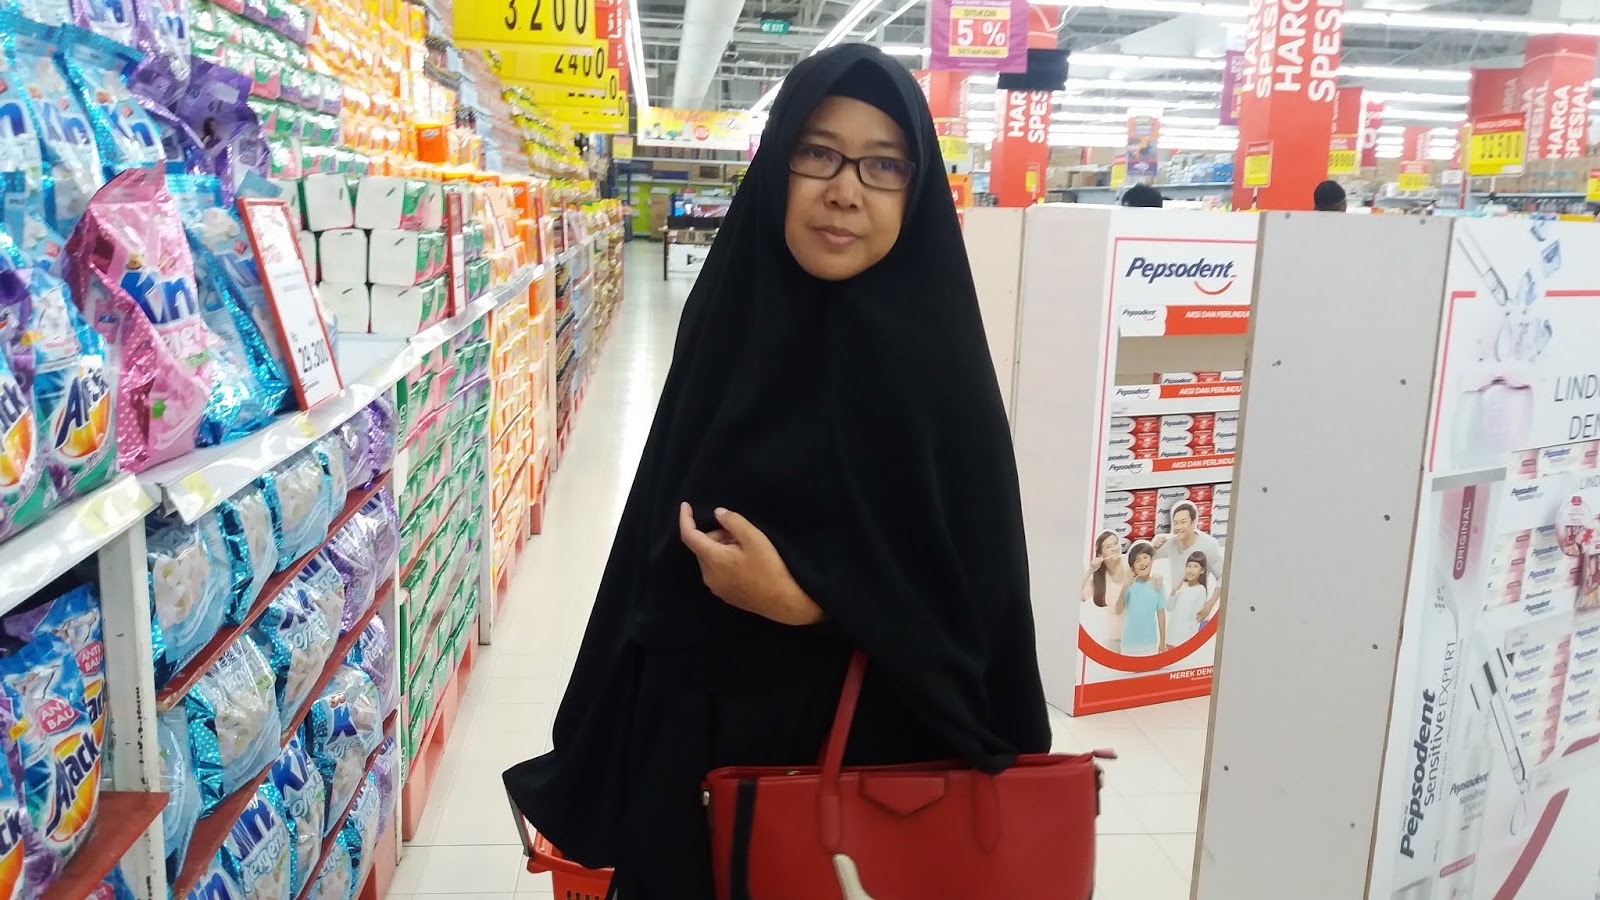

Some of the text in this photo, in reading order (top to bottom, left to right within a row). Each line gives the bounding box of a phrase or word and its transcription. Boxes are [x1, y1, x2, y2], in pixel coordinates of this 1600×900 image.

[957, 19, 974, 47] 5
[1308, 0, 1343, 102] SPESI
[1007, 90, 1027, 138] HAR
[1027, 90, 1049, 144] SPES
[1546, 85, 1571, 159] HARGA
[1563, 80, 1590, 159] SPESIAL
[1125, 256, 1236, 284] Pepsodent
[1211, 385, 1242, 394] PERLINDU
[1554, 374, 1600, 402] LIND
[1108, 462, 1143, 472] Pepsodent
[1202, 457, 1234, 466] PERLINDU
[1456, 502, 1472, 571] ORIGINAL
[1196, 668, 1213, 677] DEN
[47, 709, 75, 730] BAU
[1424, 709, 1446, 807] Sensitive
[1438, 641, 1456, 707] EXPERT
[1400, 688, 1436, 858] Pepsodent
